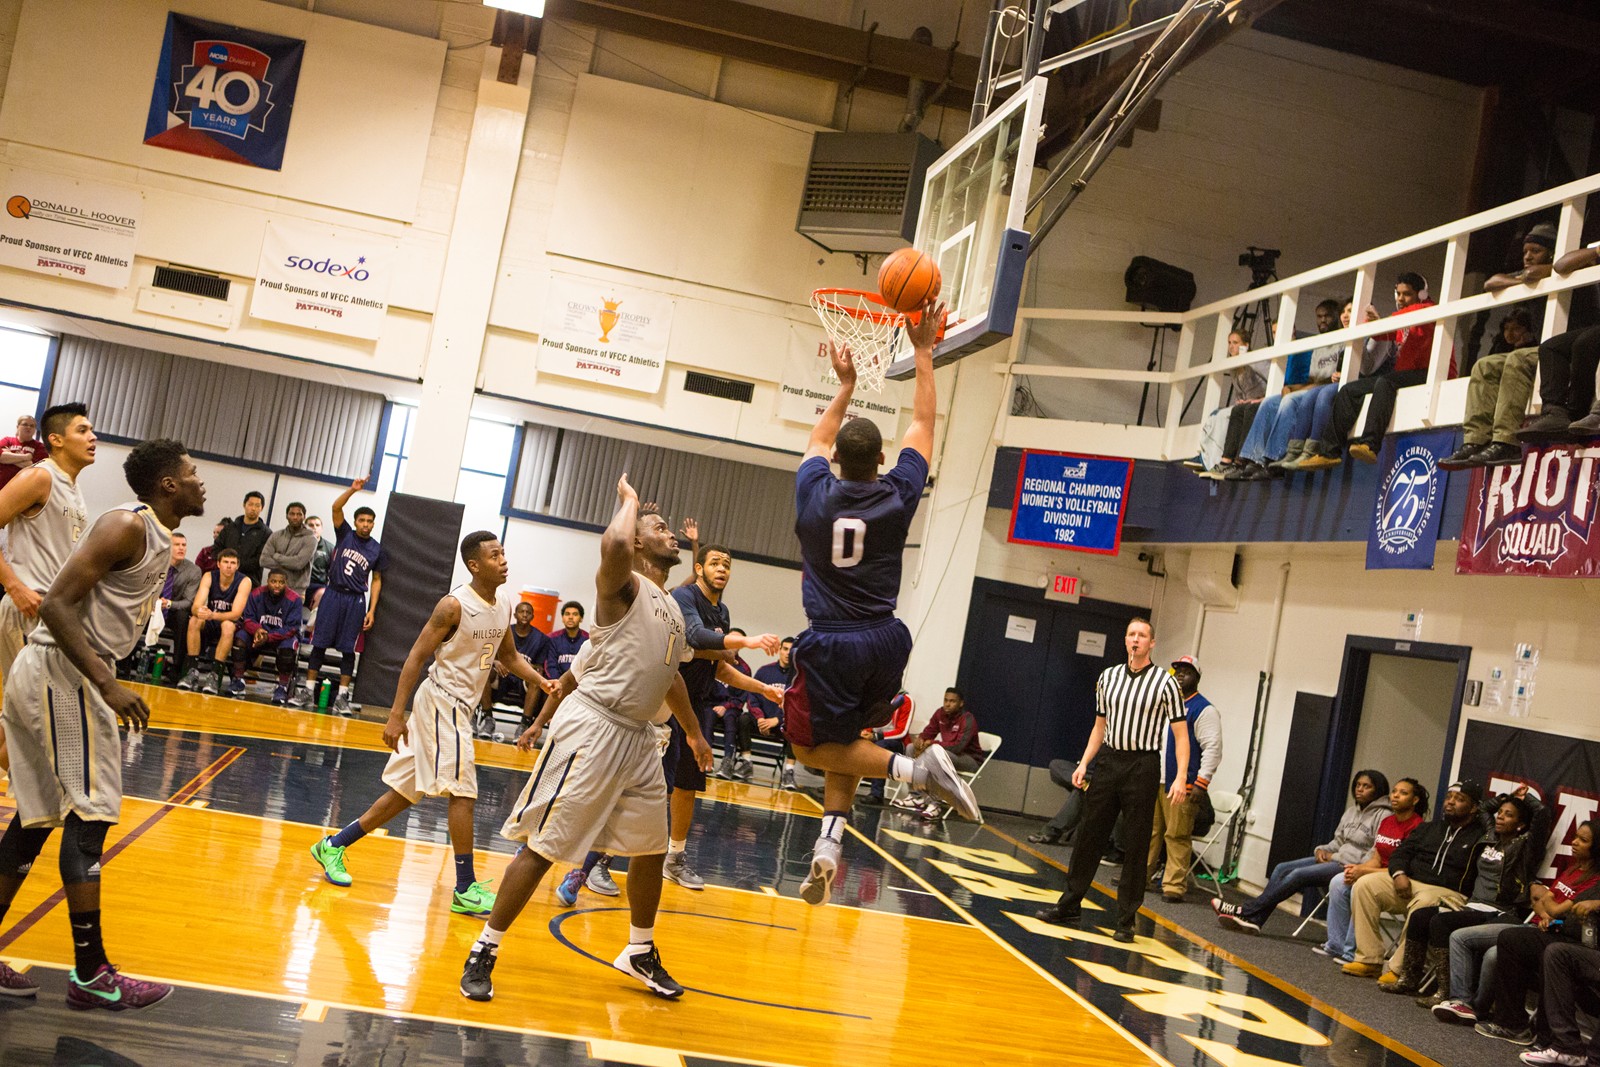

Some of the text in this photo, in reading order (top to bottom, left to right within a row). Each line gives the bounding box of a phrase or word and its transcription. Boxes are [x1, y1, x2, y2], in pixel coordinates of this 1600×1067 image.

[184, 64, 260, 115] 40
[203, 112, 237, 127] YEARS
[32, 199, 78, 214] DONALD
[91, 211, 136, 226] HOOVER
[0, 234, 23, 246] Proud
[25, 239, 61, 254] Sponsors
[63, 248, 71, 256] of
[73, 249, 93, 260] VFCC
[94, 254, 128, 267] Athletics
[37, 258, 86, 275] PATRIOTS
[284, 255, 370, 281] sodexo
[260, 278, 283, 290] Proud
[284, 283, 318, 297] Sponsors
[330, 292, 350, 303] VFCC
[351, 296, 384, 309] Athletics
[295, 302, 343, 318] PATRIOTS
[567, 301, 597, 313] CROWN
[620, 311, 651, 325] TROPHY
[542, 338, 563, 349] Proud
[565, 343, 598, 357] Sponsors
[600, 350, 607, 358] of
[609, 351, 627, 362] VFCC
[628, 355, 660, 368] Athletics
[576, 361, 621, 377] PATRIOTS
[783, 385, 804, 396] Proud
[805, 389, 835, 402] Sponsor
[866, 402, 896, 415] Athletics
[1024, 478, 1122, 499] REGIONAL CHAMPIONS
[1376, 446, 1438, 538] VALLEY FORGE CHRISTIAN COLLEGE
[1382, 469, 1431, 530] 75
[1485, 448, 1600, 531] RIOT
[1021, 493, 1119, 515] WOMEN'S VOLLEYBALL
[1043, 511, 1091, 528] DIVISION II
[831, 517, 867, 568] 0
[1054, 528, 1076, 542] 1982
[1501, 522, 1561, 555] SQUAD
[342, 548, 369, 571] PATRIOTS
[344, 560, 356, 576] 5
[1053, 575, 1078, 595] EXIT
[260, 615, 283, 628] PATRIOTS
[480, 642, 494, 670] 2
[664, 632, 676, 666] 1
